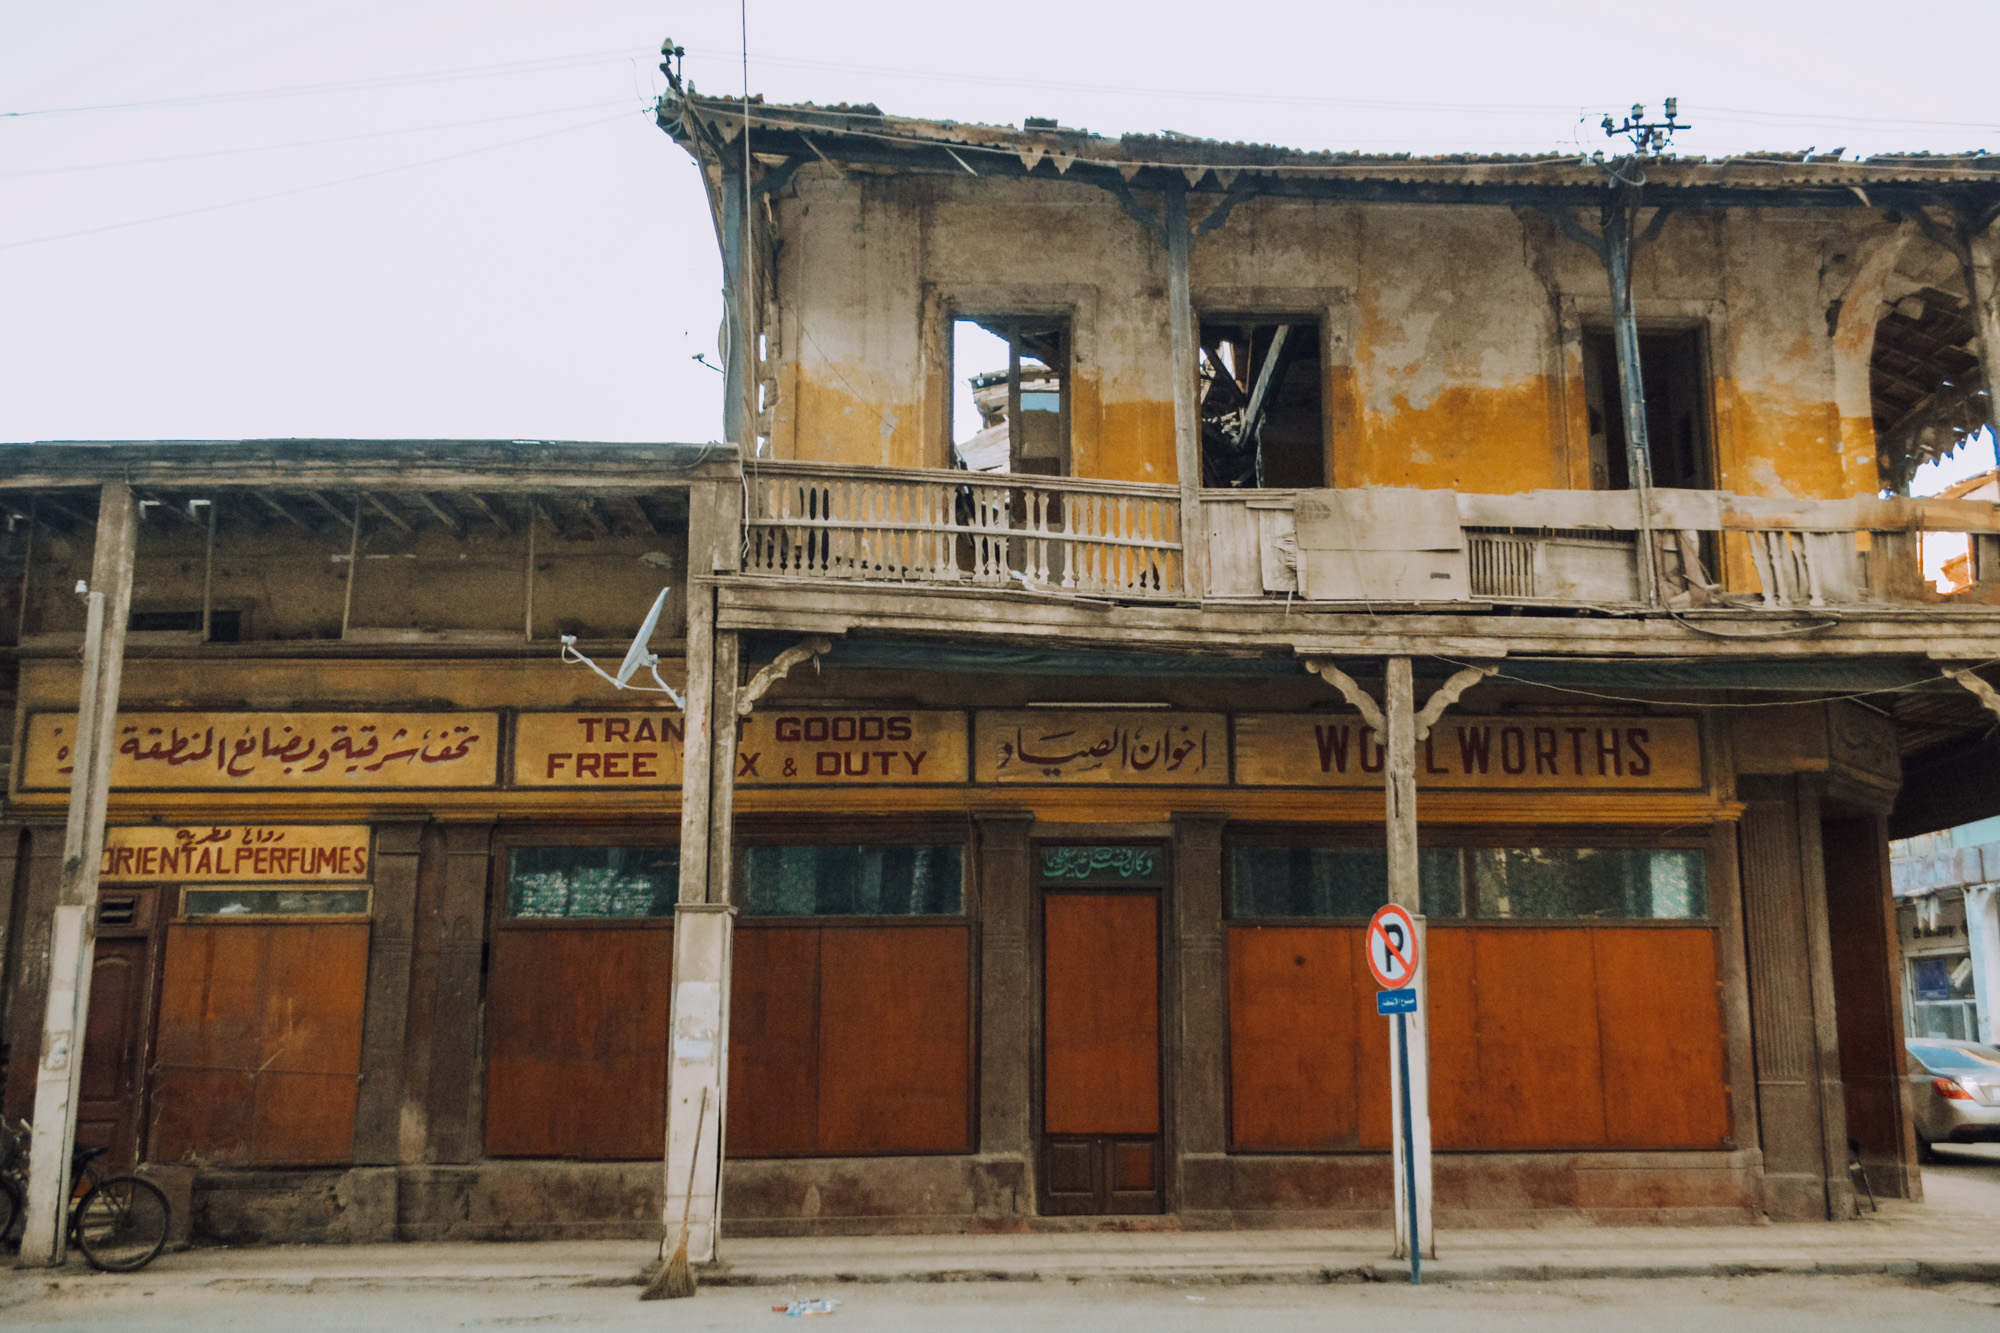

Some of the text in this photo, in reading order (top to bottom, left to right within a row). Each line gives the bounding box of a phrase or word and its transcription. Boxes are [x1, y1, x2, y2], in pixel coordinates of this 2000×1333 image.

[119, 725, 226, 771] المنطقة
[330, 725, 420, 774] شرقية
[420, 725, 480, 764] تحف
[577, 716, 913, 743] TRANT GOODS
[996, 723, 1128, 777] الصياد
[546, 752, 658, 778] FREE
[781, 756, 798, 778] &
[815, 750, 928, 776] DUTY
[1315, 725, 1652, 777] WOLWORTHS
[234, 846, 367, 876] PERFUMES
